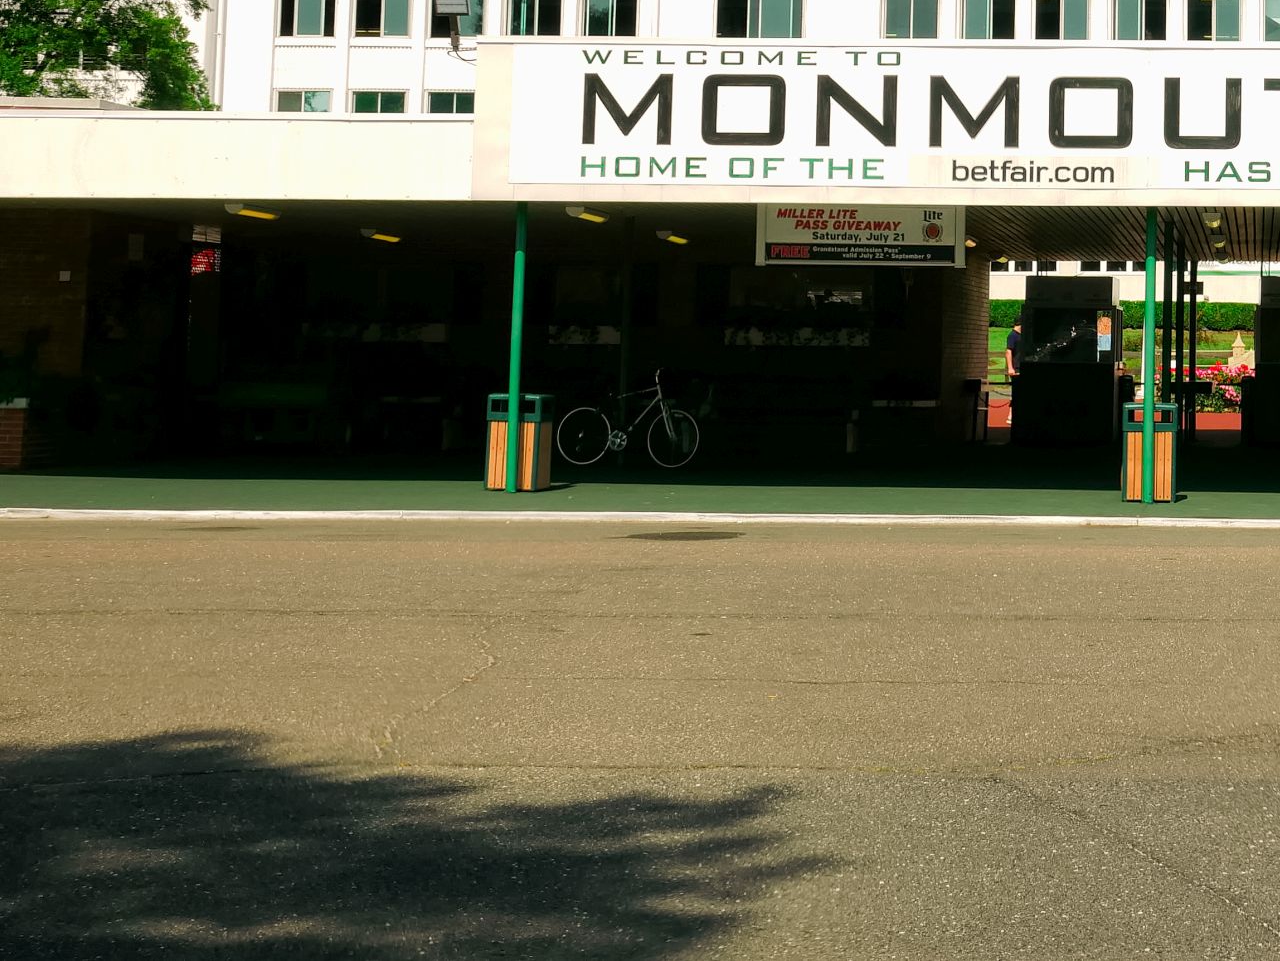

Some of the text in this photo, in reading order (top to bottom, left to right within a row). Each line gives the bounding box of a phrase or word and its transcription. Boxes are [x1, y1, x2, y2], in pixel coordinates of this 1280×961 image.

[582, 49, 902, 67] WELCOME TO
[580, 155, 707, 178] HOME
[728, 156, 785, 179] OF
[799, 157, 885, 180] THE
[952, 159, 1115, 183] betfair.com
[776, 208, 858, 219] MILLER LITE
[922, 210, 943, 222] Lite
[794, 219, 902, 232] PASS GIVEAWAY
[812, 231, 905, 244] Saturday, July 21
[771, 245, 811, 258] FREE
